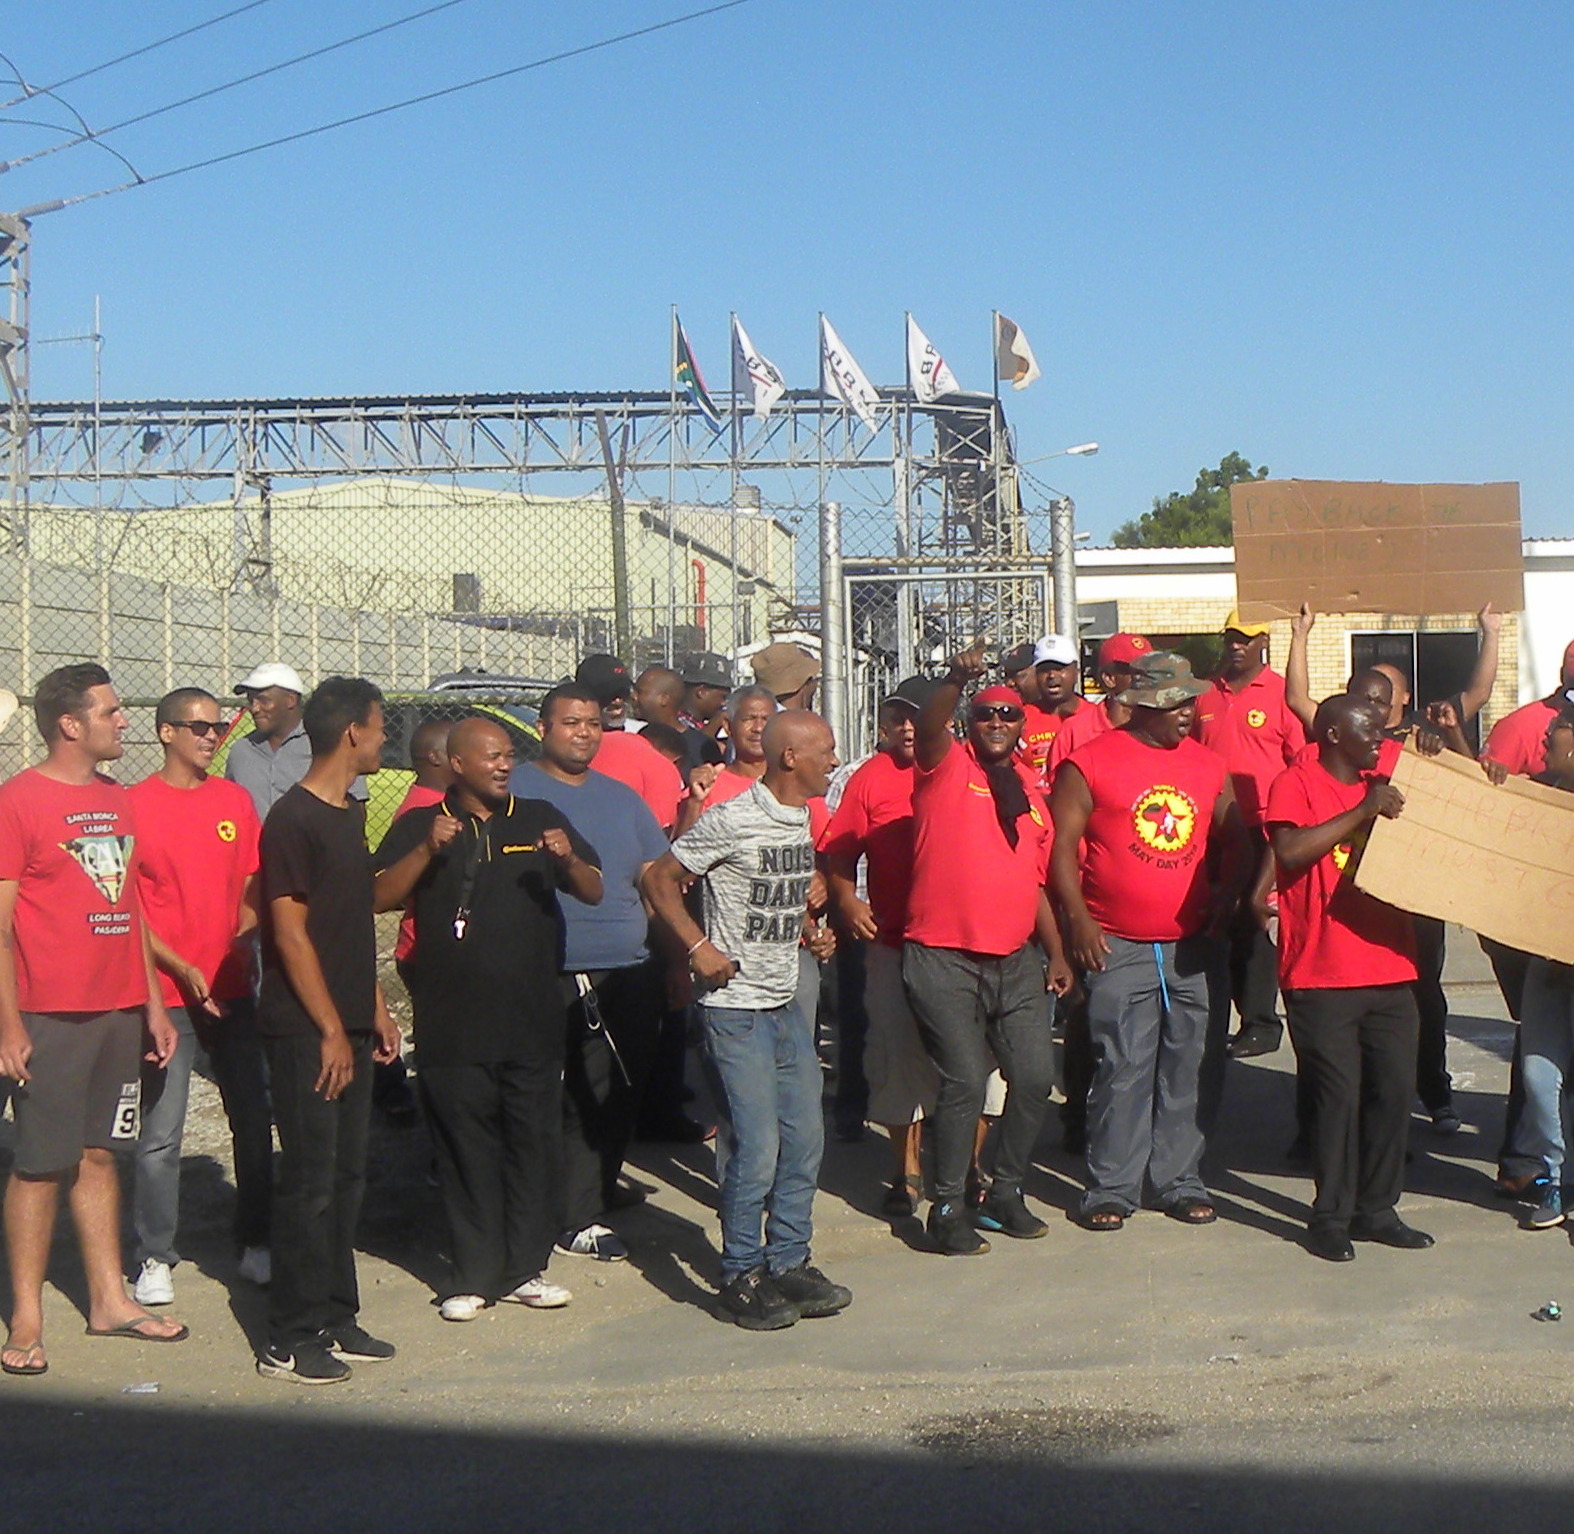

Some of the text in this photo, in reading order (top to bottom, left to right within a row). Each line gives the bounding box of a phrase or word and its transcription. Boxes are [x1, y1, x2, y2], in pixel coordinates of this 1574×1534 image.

[757, 843, 816, 877] NOIS
[1128, 842, 1153, 864] MAY
[747, 877, 812, 909] DAN
[742, 910, 806, 943] PAR
